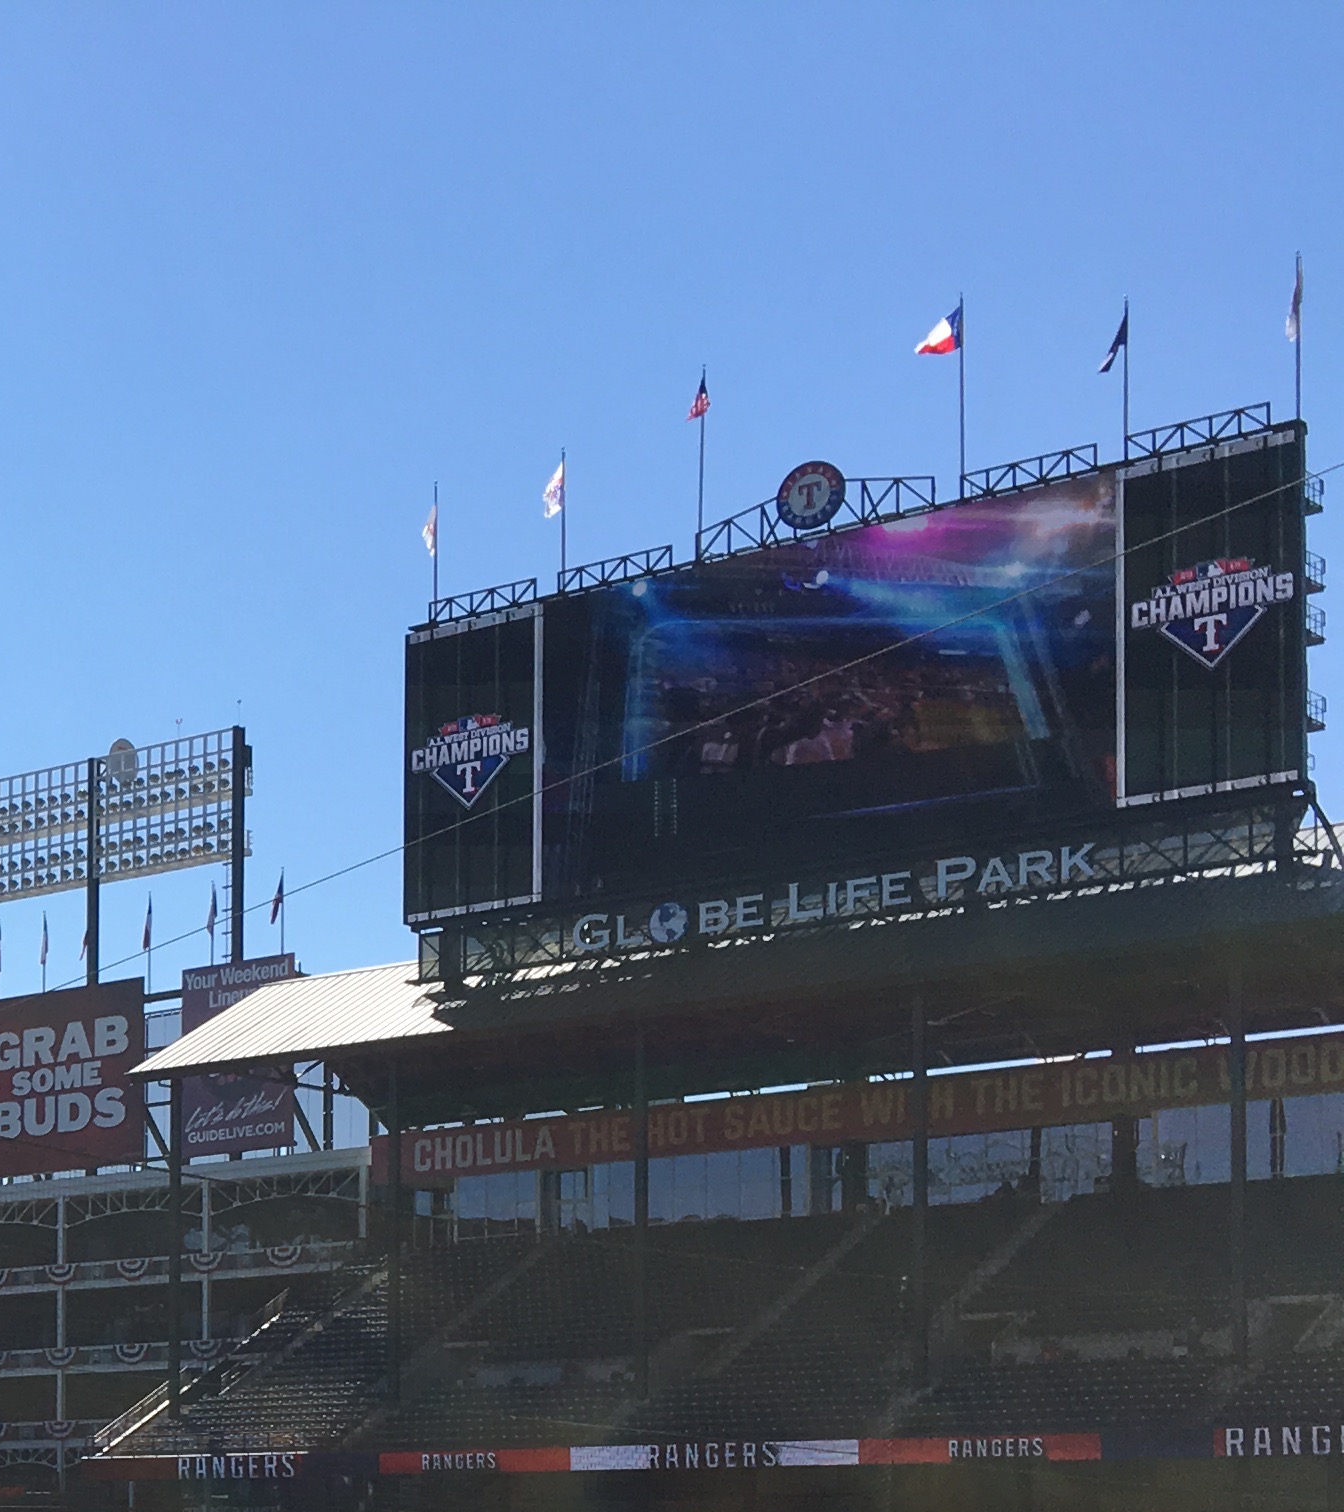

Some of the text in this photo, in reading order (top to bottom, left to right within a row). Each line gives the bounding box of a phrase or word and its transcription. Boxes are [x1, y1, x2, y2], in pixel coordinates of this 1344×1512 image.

[798, 481, 823, 509] T
[1213, 566, 1270, 588] DIVISION
[1131, 572, 1294, 629] CHAMPIONS
[1193, 613, 1228, 653] T
[470, 722, 513, 738] DIVISION
[412, 727, 530, 773] CHAMPIONS
[456, 760, 482, 794] T
[787, 870, 913, 920] LIFE
[935, 842, 1097, 899] PARK
[183, 958, 290, 992] Your Weekend
[11, 1061, 104, 1097] SOME
[413, 1123, 557, 1172] CHOLULA
[569, 1115, 631, 1156] THE
[647, 1107, 712, 1148] HOT
[722, 1093, 846, 1140] SAUCE
[859, 1077, 954, 1127] WIH
[970, 1073, 1044, 1115] THE
[1060, 1057, 1199, 1108] ICONIC
[187, 1121, 287, 1144] GUIDELIVE.COM
[648, 1442, 780, 1470] RANGERS
[948, 1437, 1044, 1459] RANGERS
[1225, 1425, 1344, 1457] RANG
[177, 1453, 296, 1480] RANGERS
[421, 1451, 497, 1472] RANGERS
